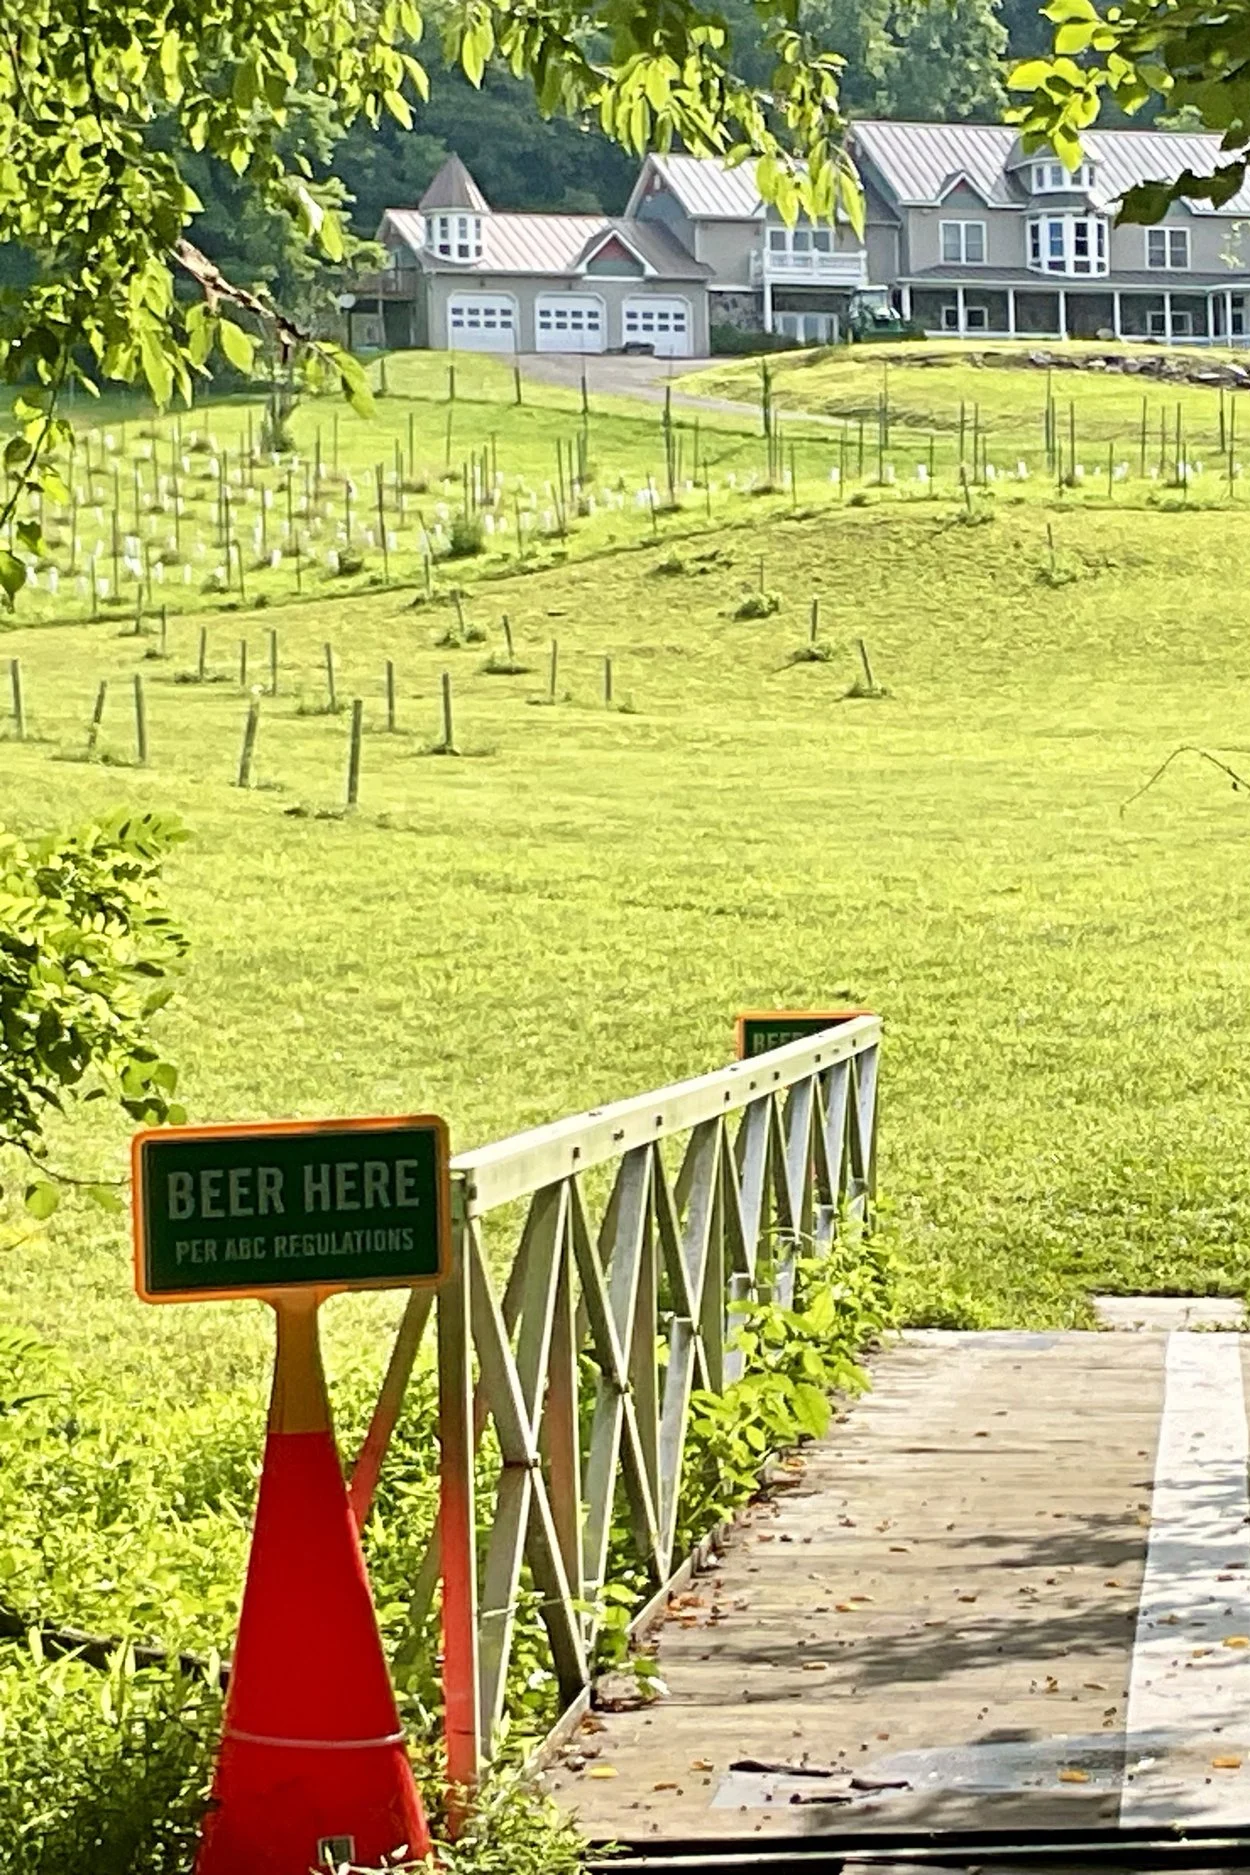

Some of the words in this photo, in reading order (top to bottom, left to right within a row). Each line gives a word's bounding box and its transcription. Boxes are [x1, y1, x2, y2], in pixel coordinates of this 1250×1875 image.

[167, 1166, 285, 1220] BEER
[303, 1159, 420, 1213] HERE
[175, 1241, 218, 1265] PER
[225, 1237, 266, 1261] ABC
[274, 1228, 415, 1259] REGULATIONS
